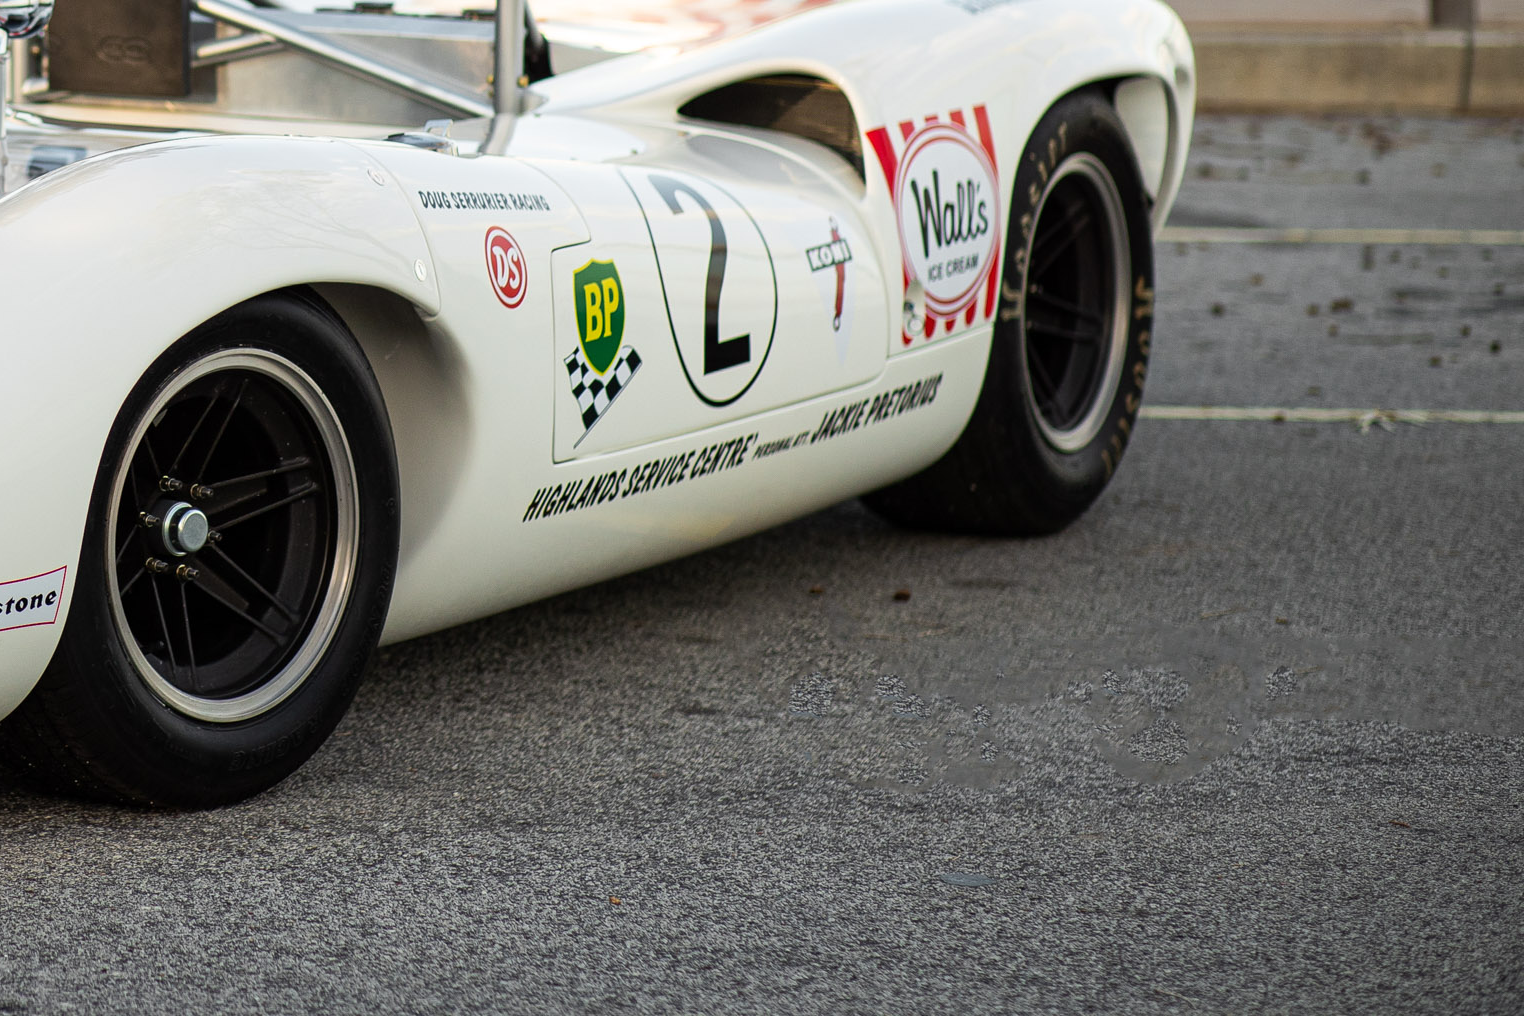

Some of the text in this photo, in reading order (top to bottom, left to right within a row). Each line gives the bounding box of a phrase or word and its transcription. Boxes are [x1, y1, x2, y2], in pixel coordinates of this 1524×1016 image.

[418, 190, 551, 211] DOUG SERRURIER RACING
[910, 168, 988, 259] Wall's
[491, 245, 521, 289] DS
[648, 175, 751, 376] 2
[806, 239, 852, 271] KONI
[929, 254, 979, 283] ICE CREAM
[584, 277, 619, 342] BP
[523, 467, 627, 522] HIGHLANDS
[622, 450, 696, 498] SERVICE
[810, 398, 869, 444] JACKIE
[864, 372, 943, 427] PRETORIUS
